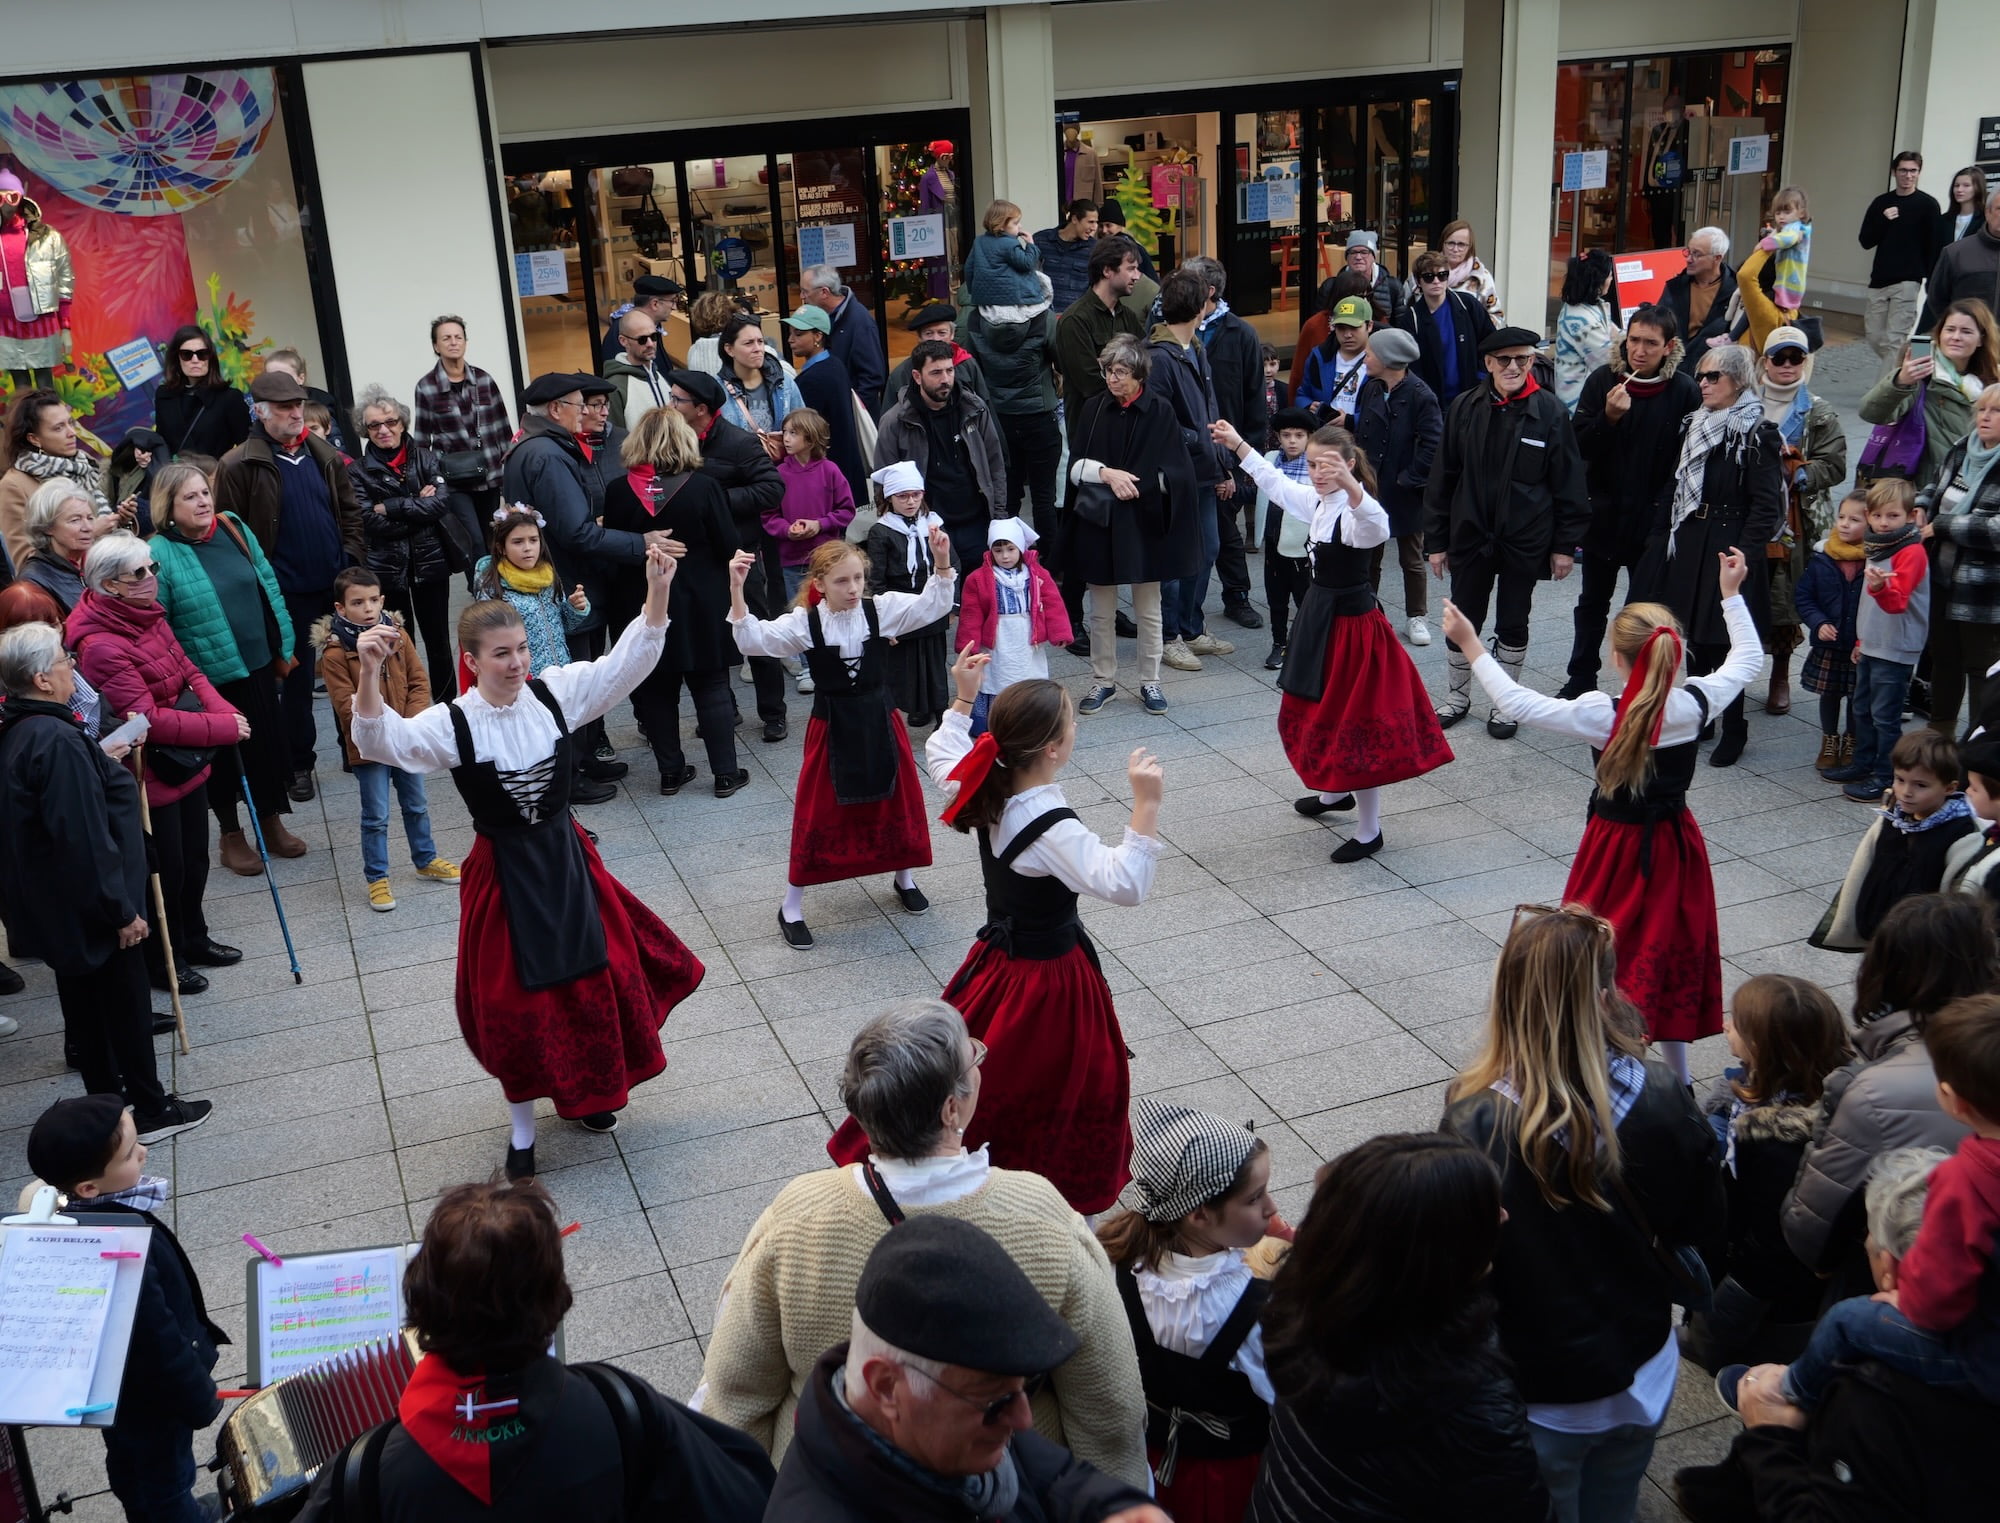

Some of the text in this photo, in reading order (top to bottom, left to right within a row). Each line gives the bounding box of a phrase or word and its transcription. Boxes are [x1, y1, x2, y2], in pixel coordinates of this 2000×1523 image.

[1742, 146, 1762, 159] -20%
[895, 224, 904, 253] OFFRE
[907, 227, 934, 242] -20%
[826, 240, 850, 252] -25%
[28, 1236, 102, 1245] AXURI BELTZA
